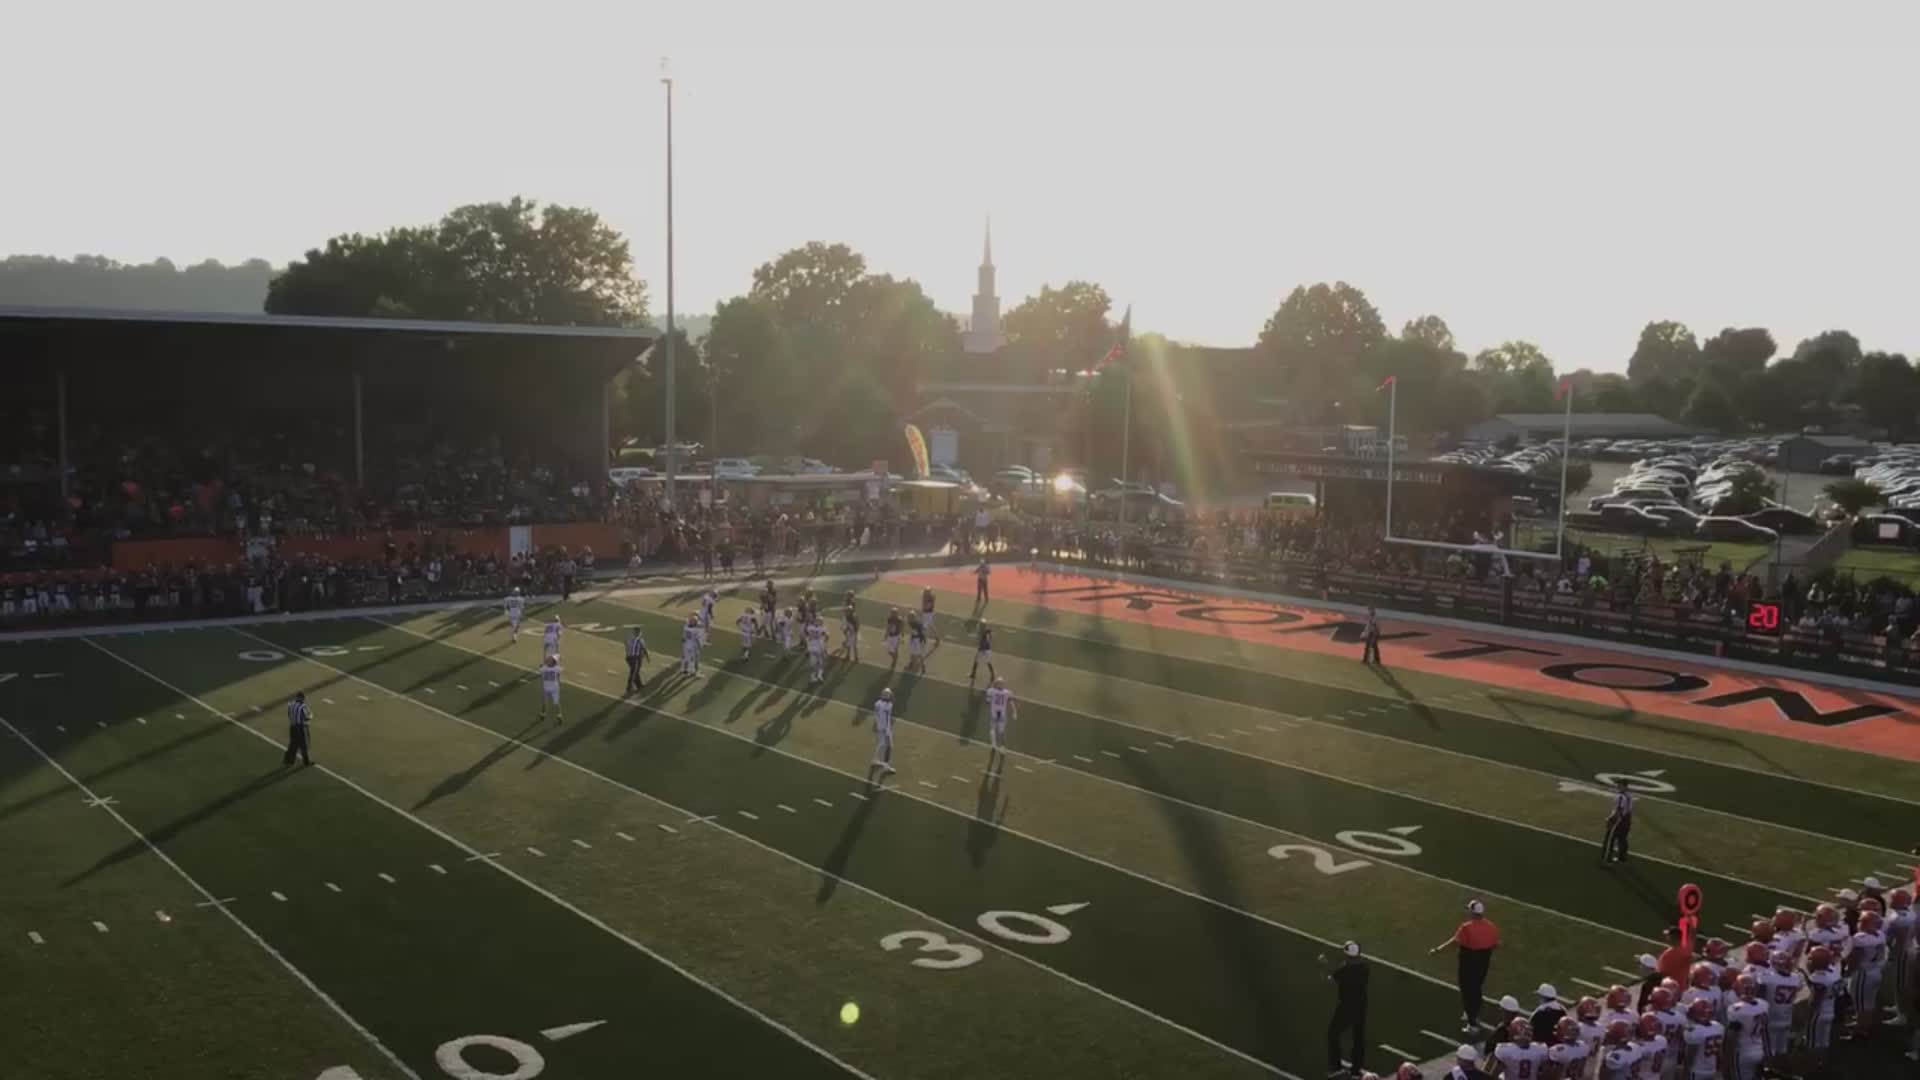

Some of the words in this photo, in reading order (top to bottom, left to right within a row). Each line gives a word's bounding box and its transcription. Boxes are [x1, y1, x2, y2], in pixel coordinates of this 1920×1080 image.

[1750, 603, 1778, 628] 20
[1032, 585, 1904, 727] IRONTON
[1267, 828, 1423, 876] 20
[880, 909, 1072, 970] 30
